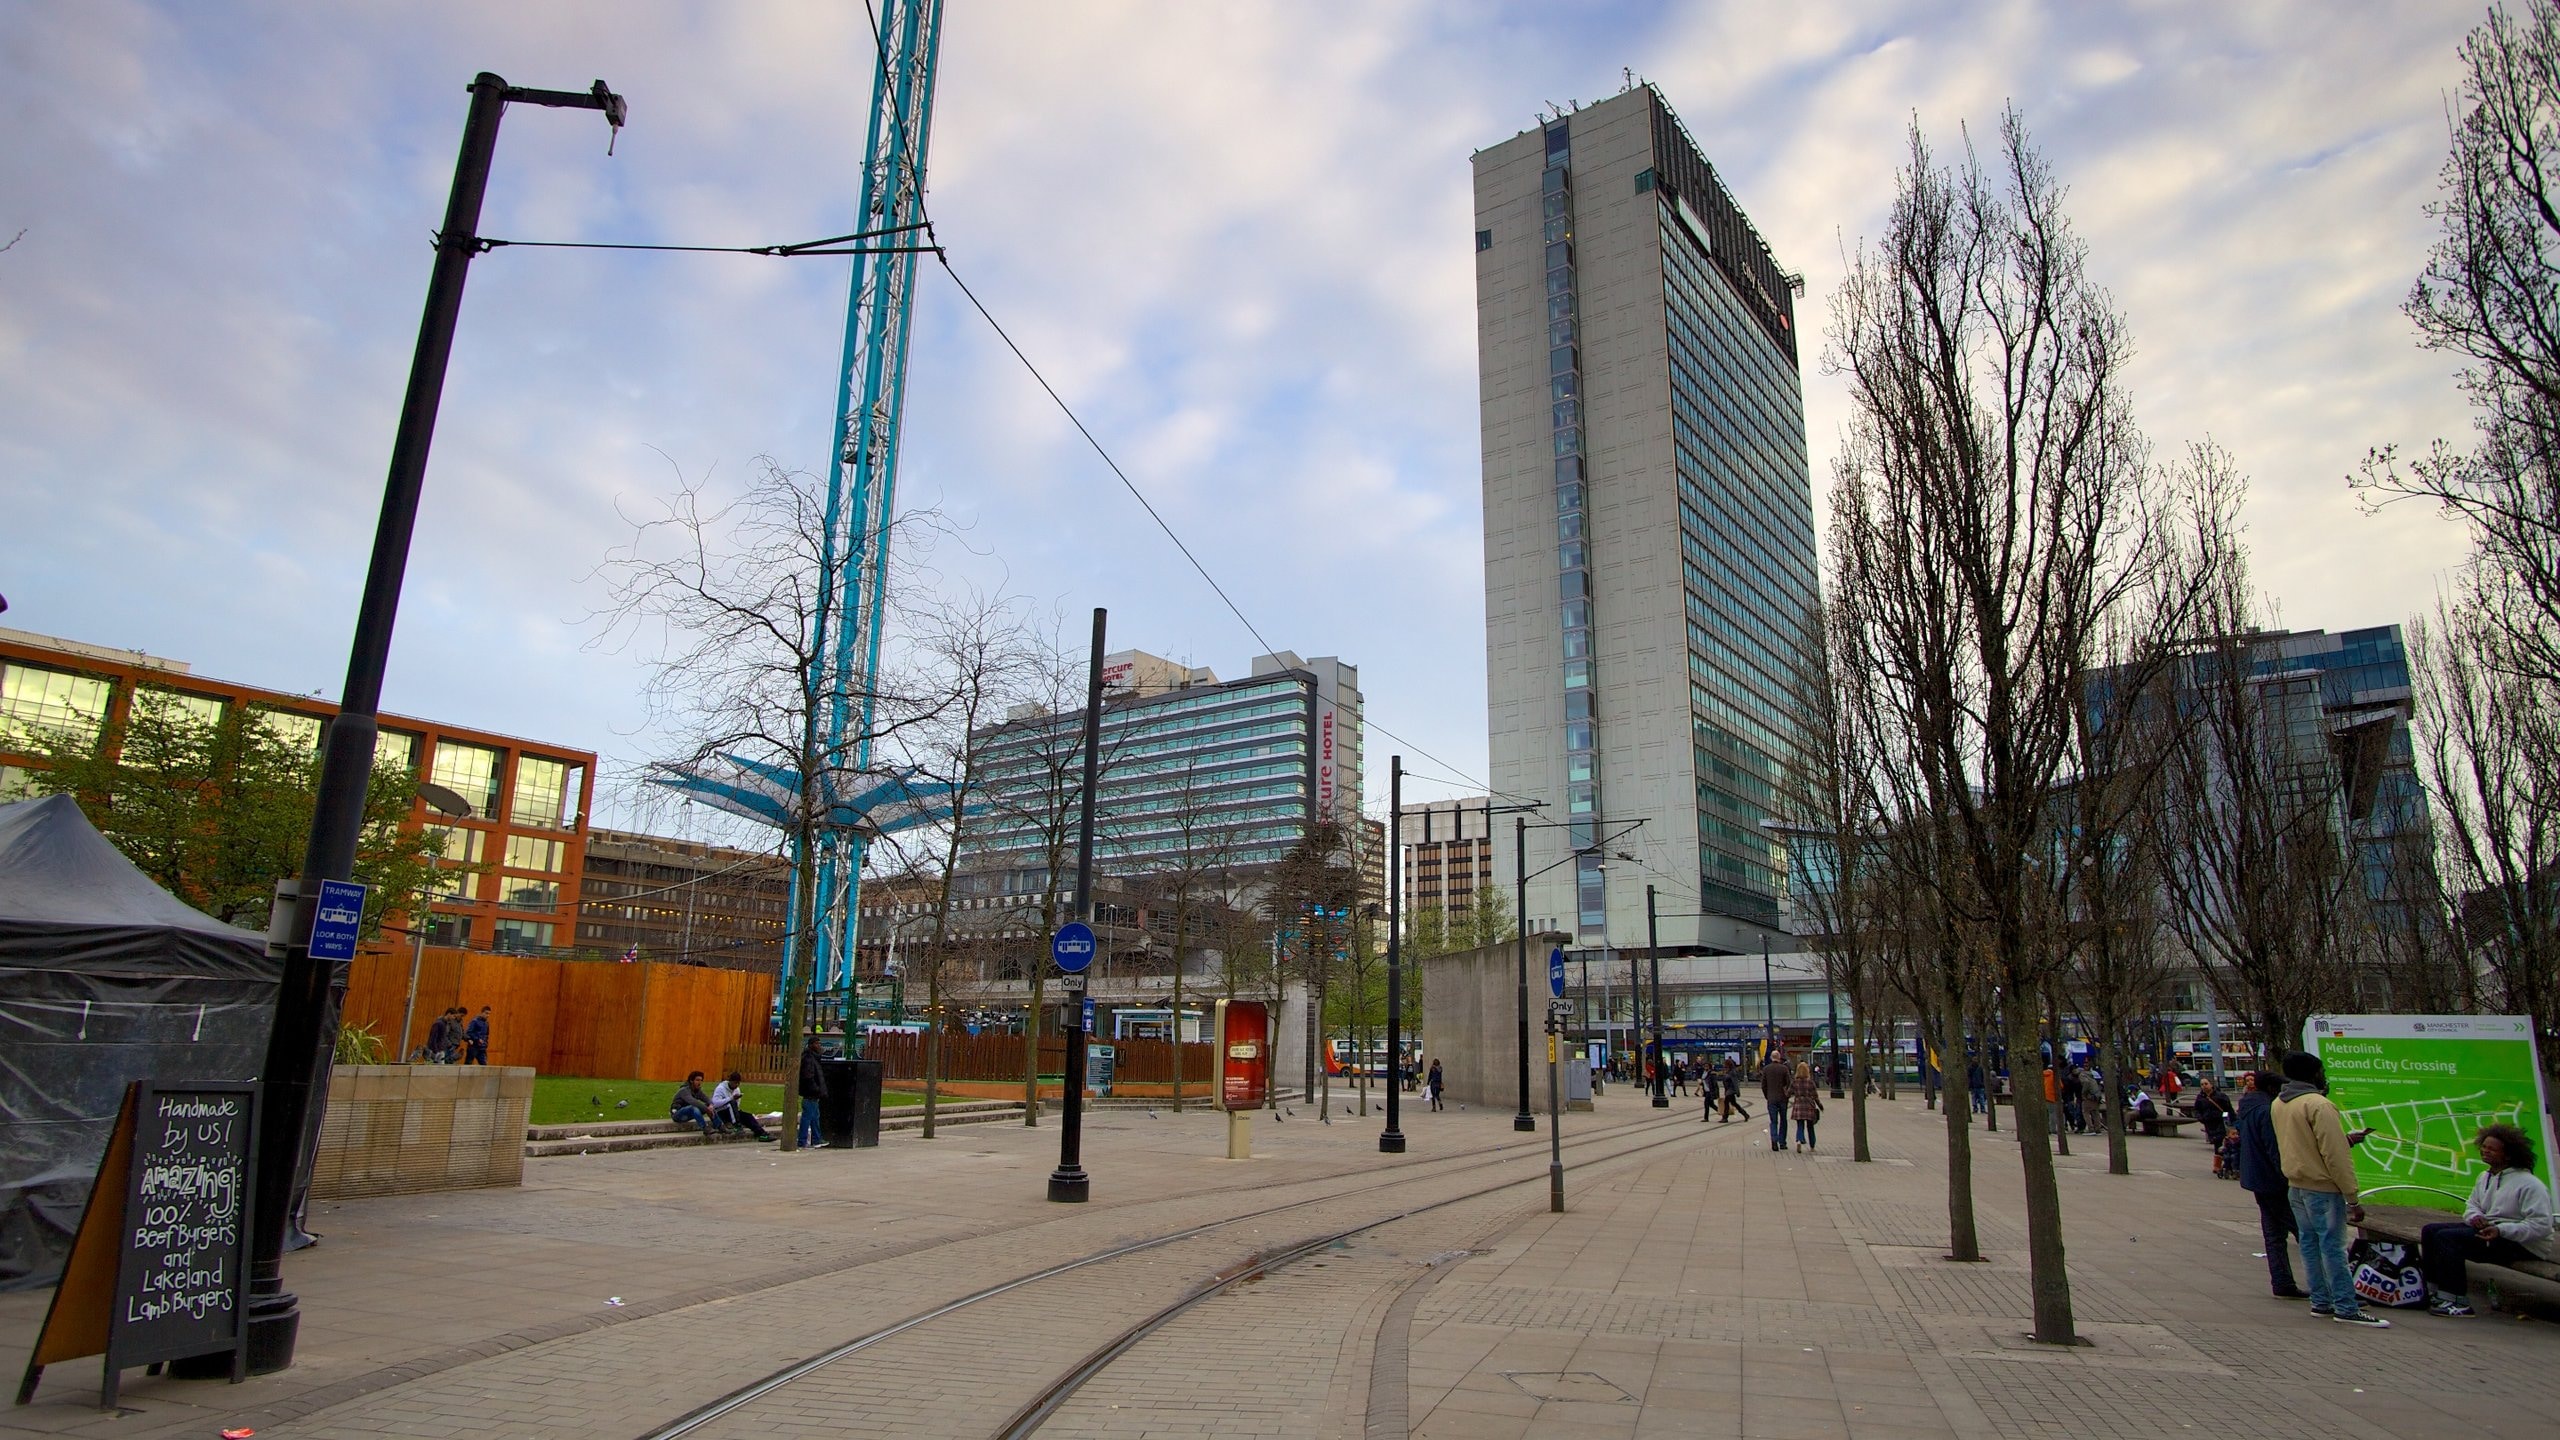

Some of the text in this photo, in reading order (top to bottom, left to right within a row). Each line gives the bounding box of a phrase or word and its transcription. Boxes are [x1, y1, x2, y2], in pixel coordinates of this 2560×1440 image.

[1103, 663, 1133, 675] ercure
[1321, 711, 1333, 827] ercure HOTEL
[325, 886, 362, 898] TRAMWAY
[315, 930, 355, 941] LOOK BOTH
[324, 942, 343, 951] WAYS
[1063, 977, 1083, 988] Only
[1551, 1002, 1572, 1011] Only
[2325, 1042, 2384, 1055] Metrolink
[2326, 1057, 2457, 1075] Second City Crossing
[159, 1096, 238, 1118] Handmade
[162, 1121, 188, 1155] by
[144, 1201, 193, 1226] 100%
[134, 1223, 236, 1250] Beef Burgers
[163, 1247, 192, 1268] and
[142, 1256, 223, 1293] Lakeland
[127, 1288, 232, 1322] Lamb Burgers
